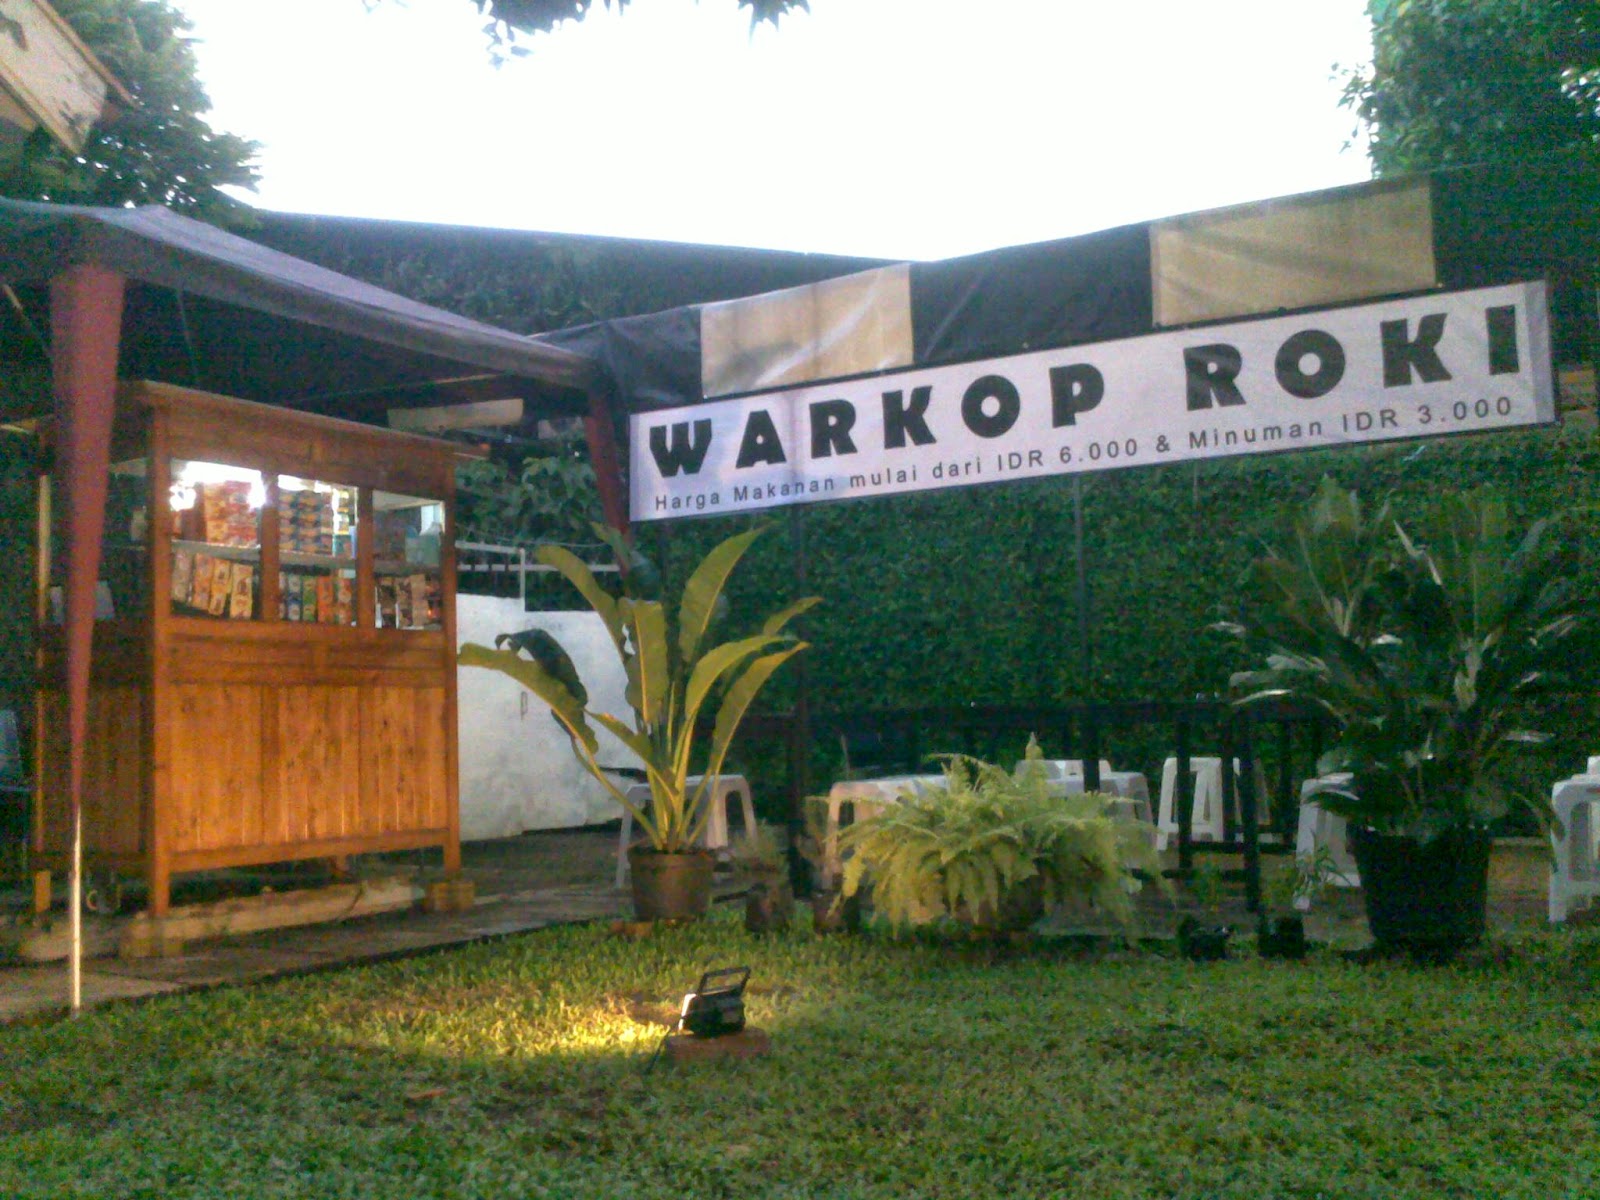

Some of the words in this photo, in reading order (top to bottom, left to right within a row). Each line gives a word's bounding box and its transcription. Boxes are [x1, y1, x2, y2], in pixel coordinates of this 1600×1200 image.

[649, 363, 1105, 478] WARKOP
[1183, 304, 1520, 411] ROKI
[655, 491, 721, 511] Harga
[733, 476, 835, 502] Makanan
[849, 465, 917, 487] mulai
[932, 457, 982, 479] dari
[998, 450, 1044, 471] IDR
[1059, 438, 1138, 463] 6.000
[1155, 435, 1171, 453] &
[1189, 419, 1322, 450] Minuman
[1342, 410, 1399, 433] IDR
[1418, 396, 1512, 425] 3.000
